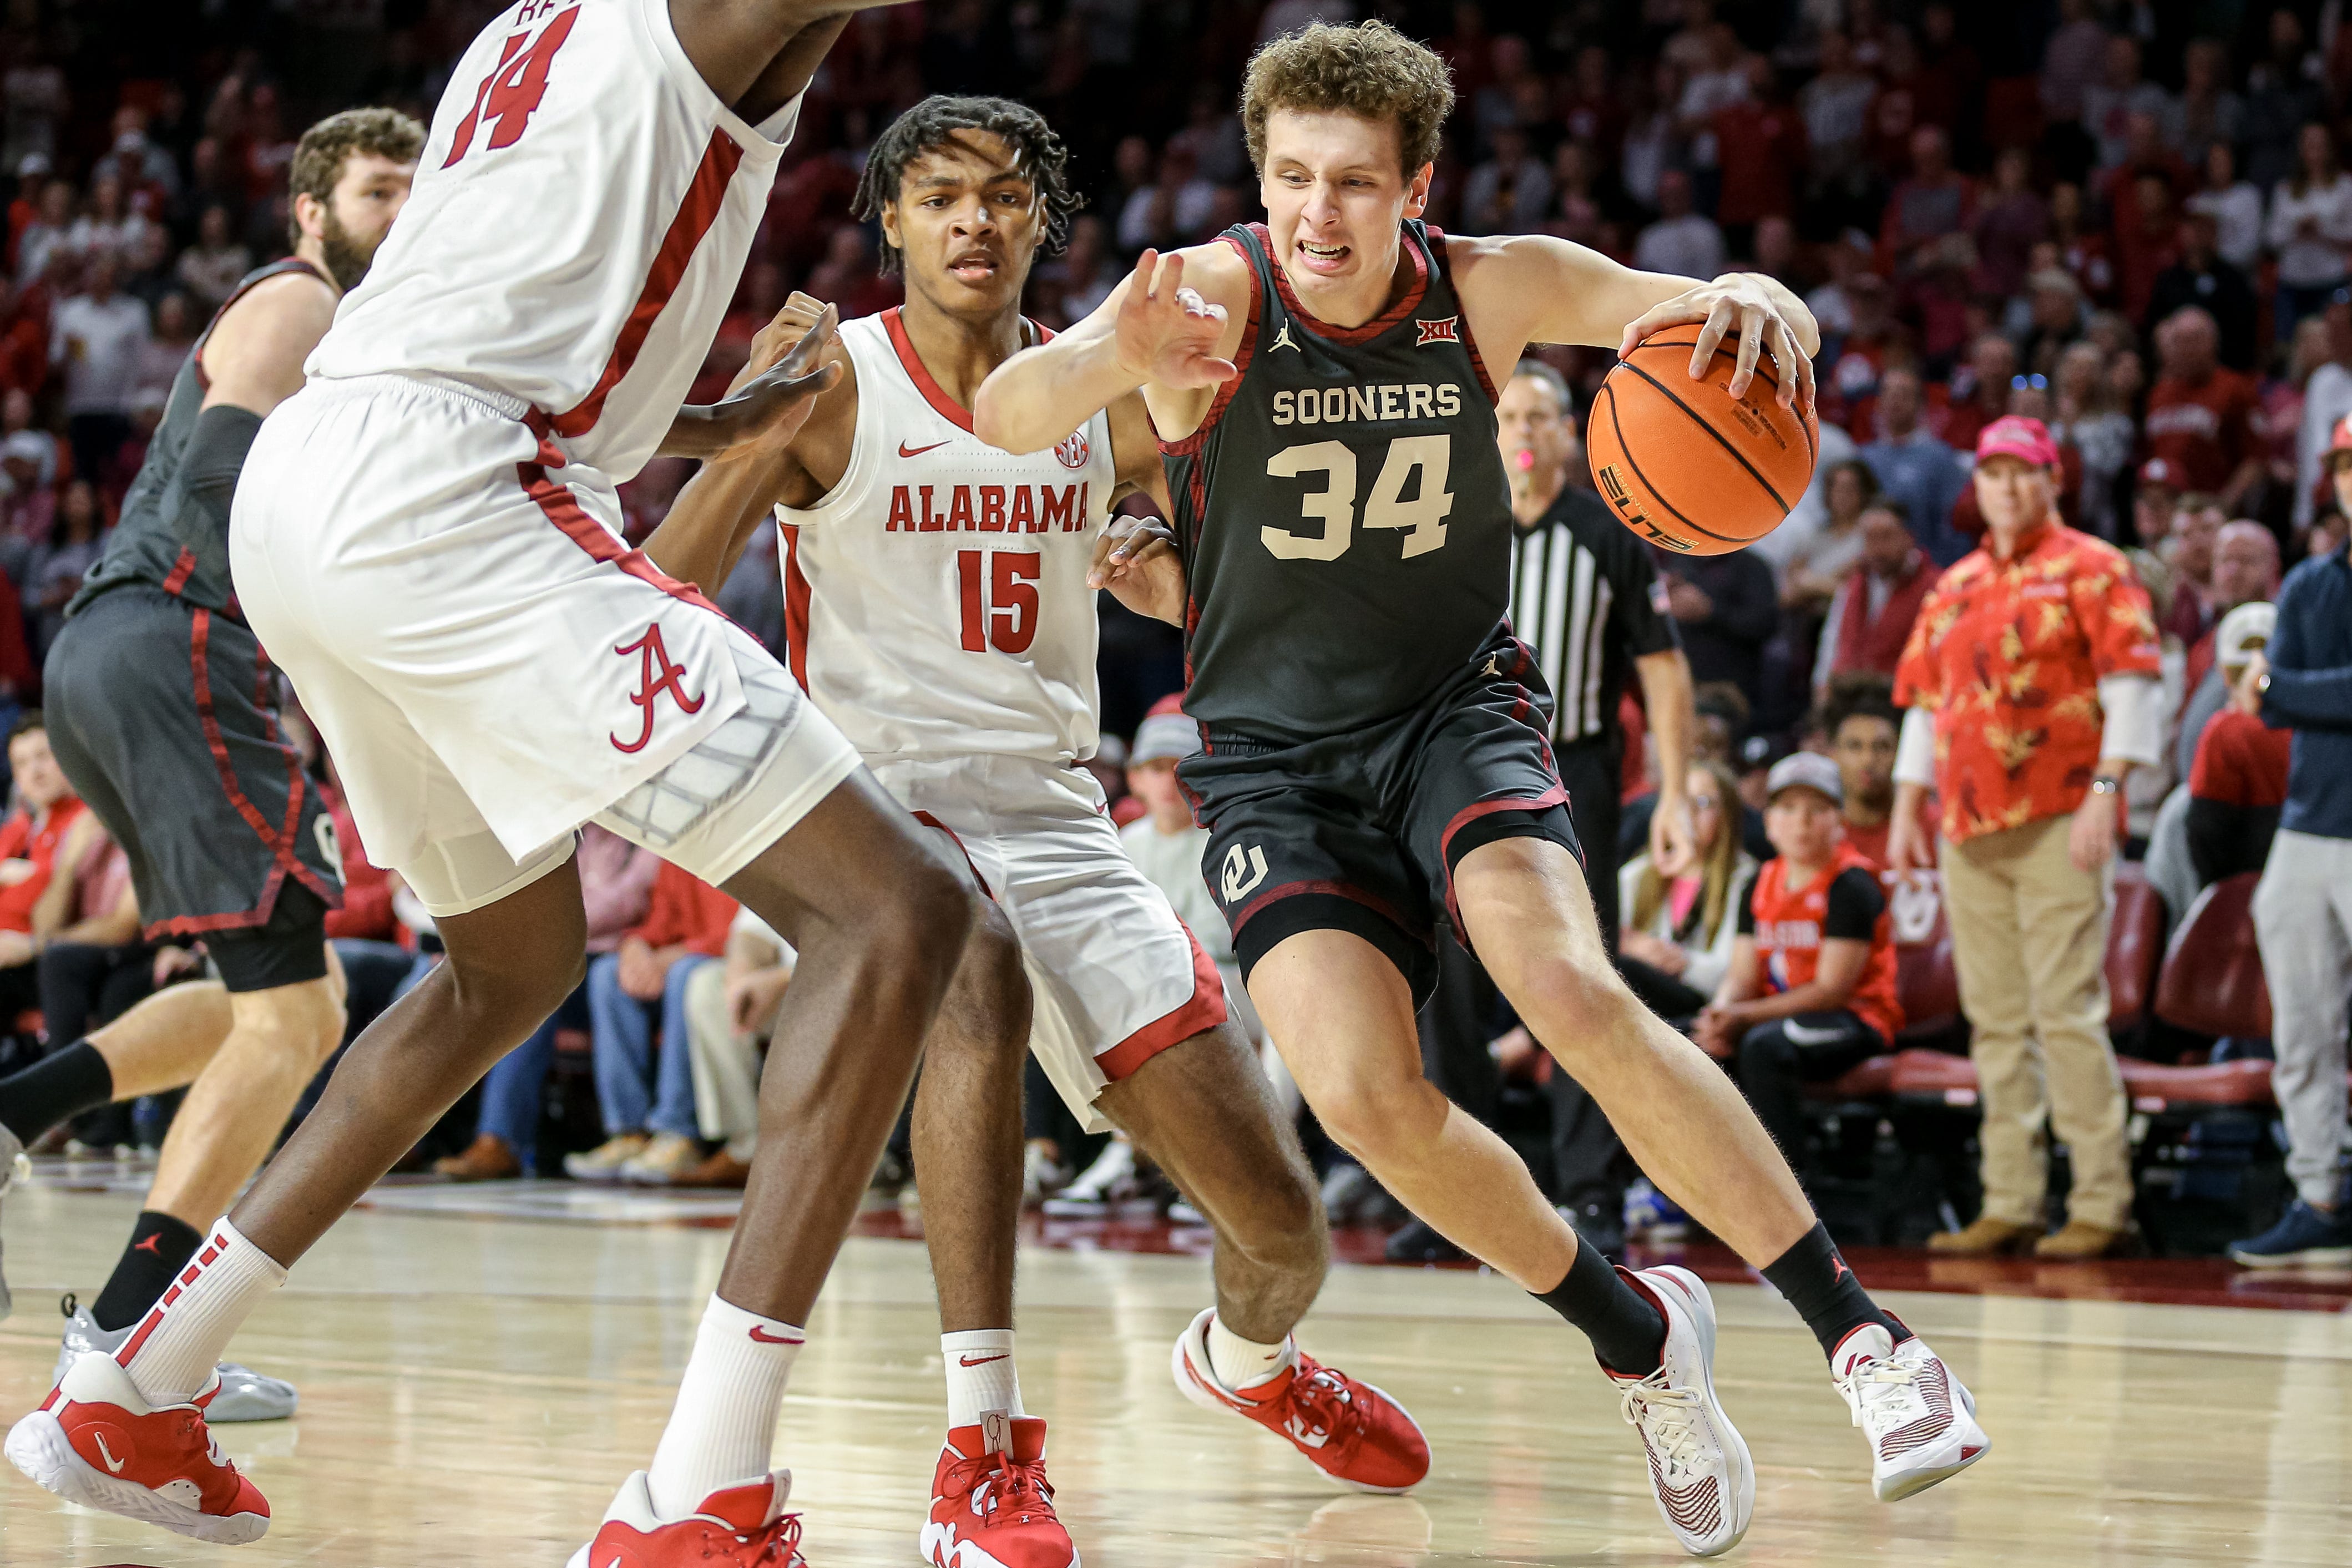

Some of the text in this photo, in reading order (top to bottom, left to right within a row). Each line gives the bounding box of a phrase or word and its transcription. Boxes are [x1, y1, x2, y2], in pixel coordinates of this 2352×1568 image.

[441, 3, 582, 169] 14
[1056, 432, 1088, 467] SEC
[1273, 383, 1461, 426] SOONERS
[1260, 433, 1454, 562] 34
[1599, 465, 1695, 552] ELITE
[1612, 463, 1699, 546] CHAPIONSHIP
[957, 550, 1041, 654] 15
[610, 622, 705, 753] A
